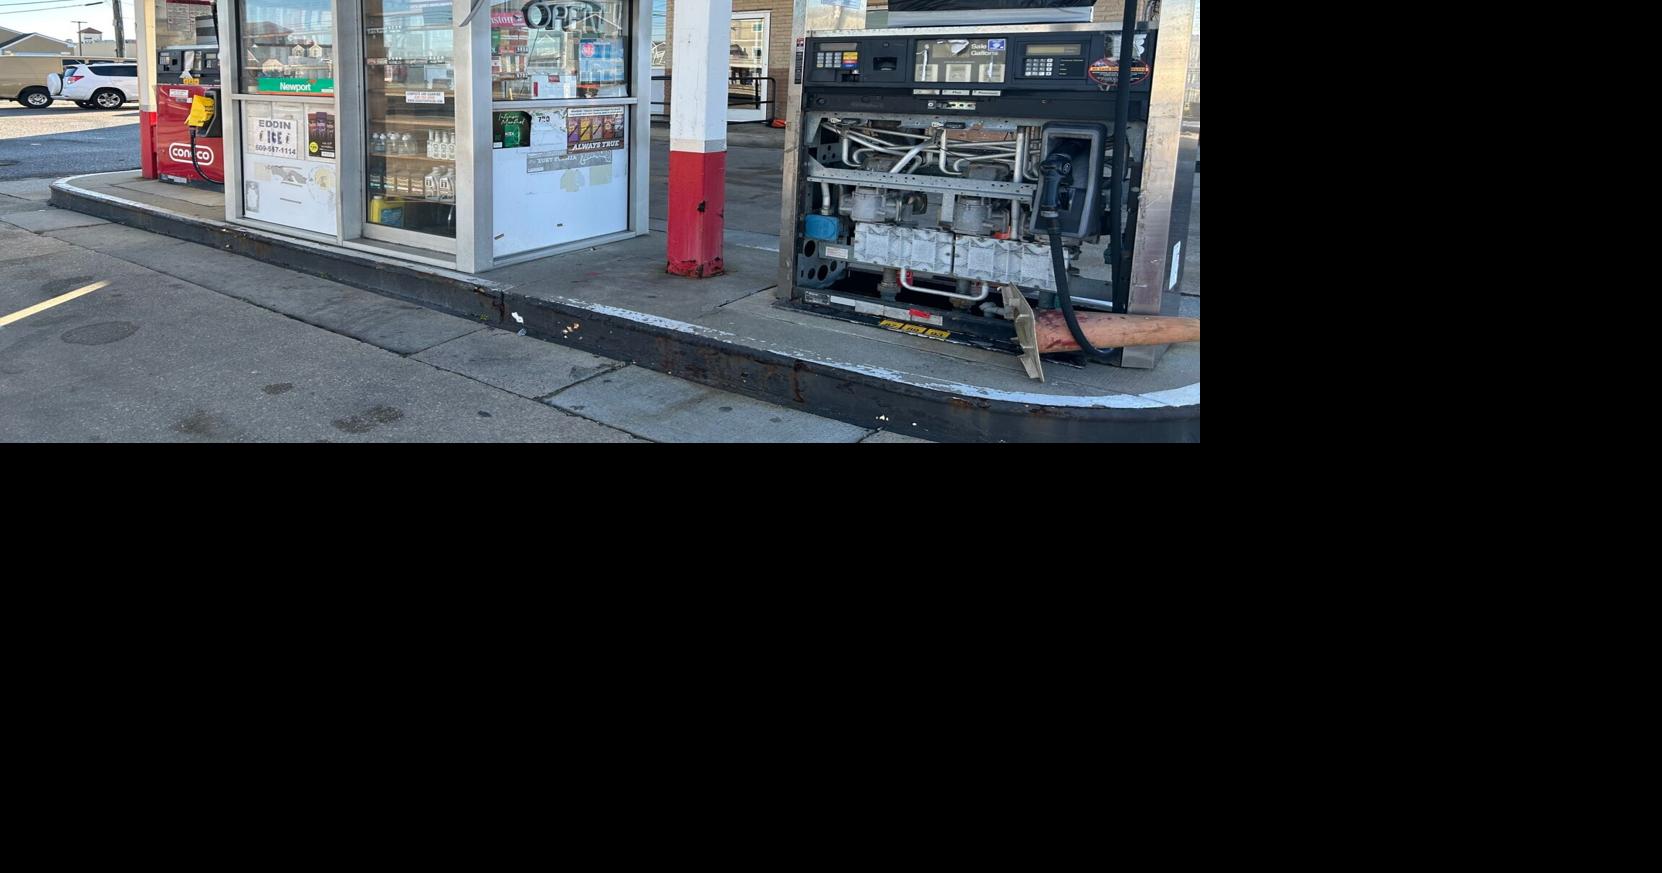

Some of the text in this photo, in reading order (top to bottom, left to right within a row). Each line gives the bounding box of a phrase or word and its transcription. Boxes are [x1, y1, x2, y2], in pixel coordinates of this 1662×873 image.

[280, 82, 312, 92] Newport
[258, 120, 292, 130] EDDIN
[267, 131, 283, 144] ICE
[571, 140, 620, 151] ALWAYS TRUE
[172, 147, 211, 160] conco
